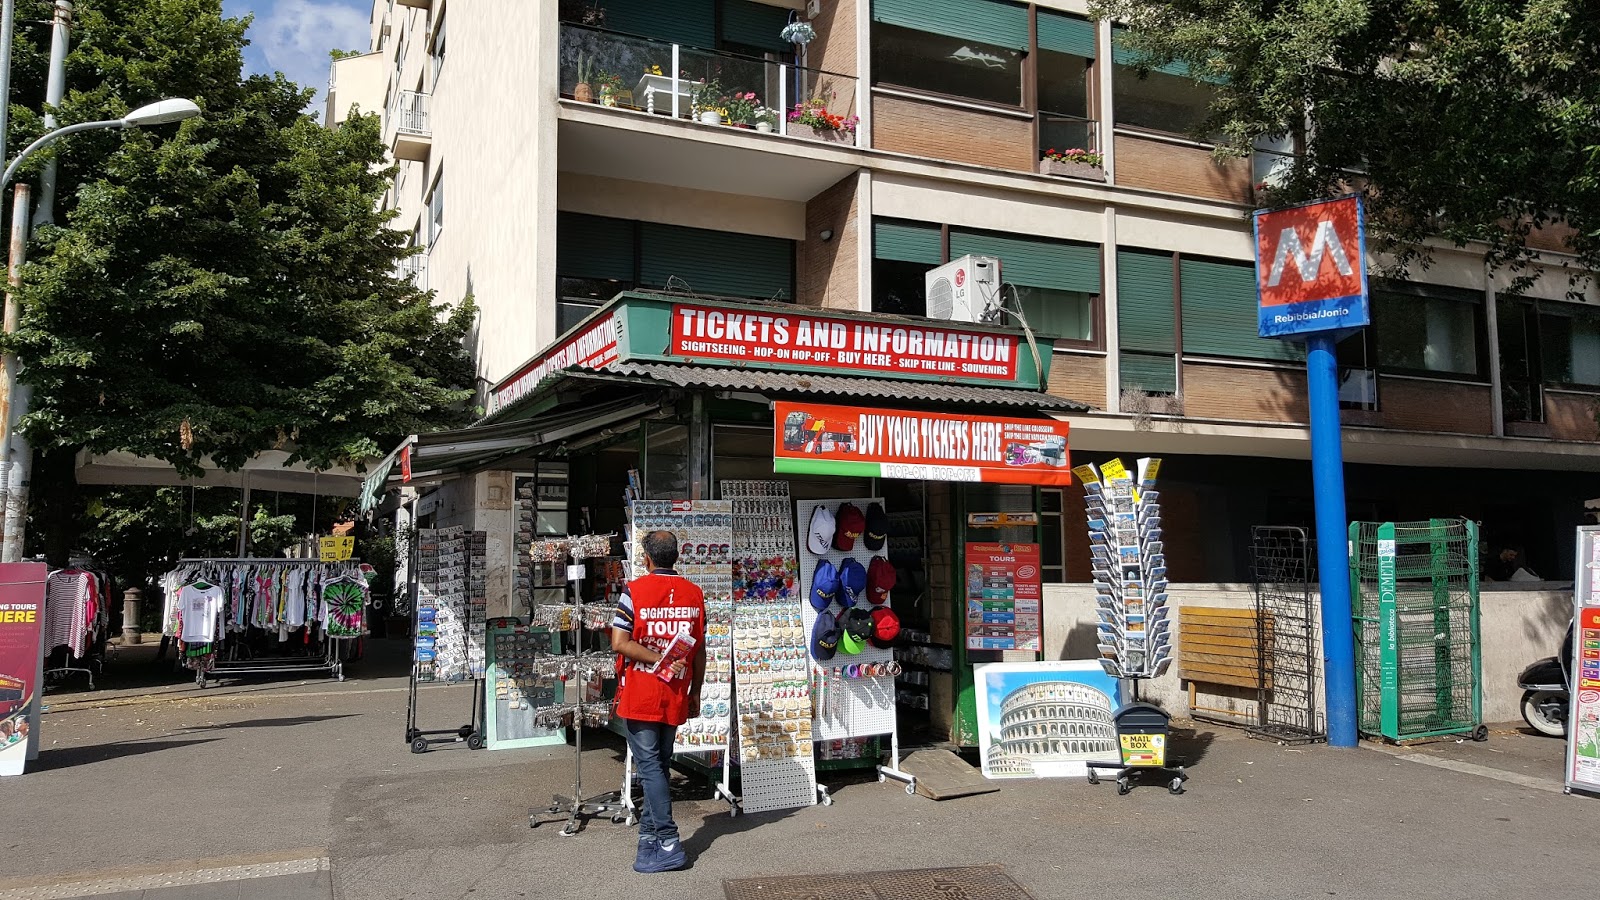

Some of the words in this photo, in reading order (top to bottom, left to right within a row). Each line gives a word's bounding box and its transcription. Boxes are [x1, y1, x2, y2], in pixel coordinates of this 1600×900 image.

[1266, 219, 1354, 288] M
[956, 288, 965, 299] LG
[1274, 307, 1349, 324] Rebibbia/Jonio
[680, 308, 789, 345] TICKETS
[796, 320, 848, 349] AND
[854, 325, 1010, 363] INFORMATION
[681, 340, 746, 356] SIGHTSEEING
[753, 347, 790, 360] HOP-ON
[791, 350, 831, 363] HOP-OFF
[837, 350, 861, 365] BUY
[863, 353, 892, 367] HERE
[898, 358, 919, 370] SKIP
[920, 360, 936, 371] THE
[937, 361, 955, 372] LINE
[961, 362, 1008, 376] SOUVENIRS
[858, 414, 884, 455] BUY
[886, 416, 919, 458] YOUR
[921, 418, 969, 461] TICKETS
[971, 422, 1002, 462] HERE
[886, 464, 927, 479] HOP-ON
[932, 467, 976, 481] HOP-OFF
[1381, 556, 1395, 604] DEMETR
[668, 589, 674, 604] i
[640, 606, 700, 620] SIGHTSEEING
[639, 636, 670, 648] OP-ON
[1130, 735, 1150, 743] MAIL
